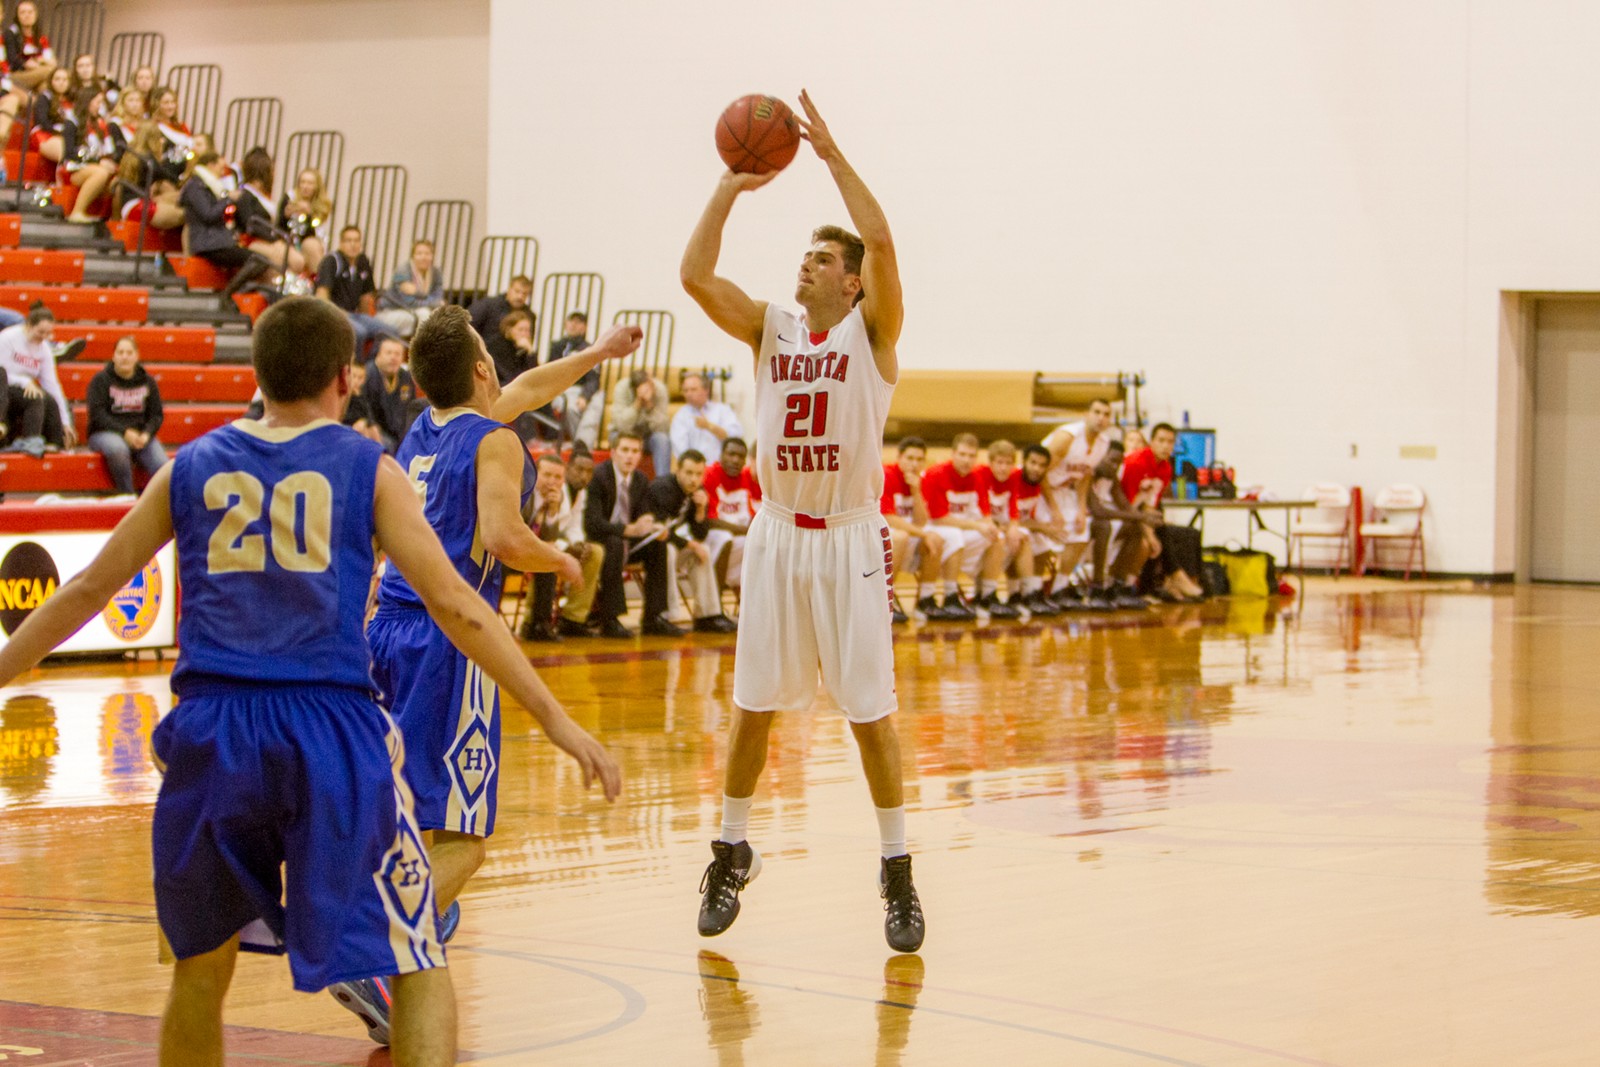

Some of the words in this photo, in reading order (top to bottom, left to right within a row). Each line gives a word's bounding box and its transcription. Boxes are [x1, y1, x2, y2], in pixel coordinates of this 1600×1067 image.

[770, 351, 849, 383] ONEONTA
[783, 391, 828, 438] 21
[776, 444, 839, 472] STATE
[203, 470, 333, 574] 20
[0, 576, 57, 610] NCAA
[463, 748, 483, 771] H
[399, 859, 420, 886] H
